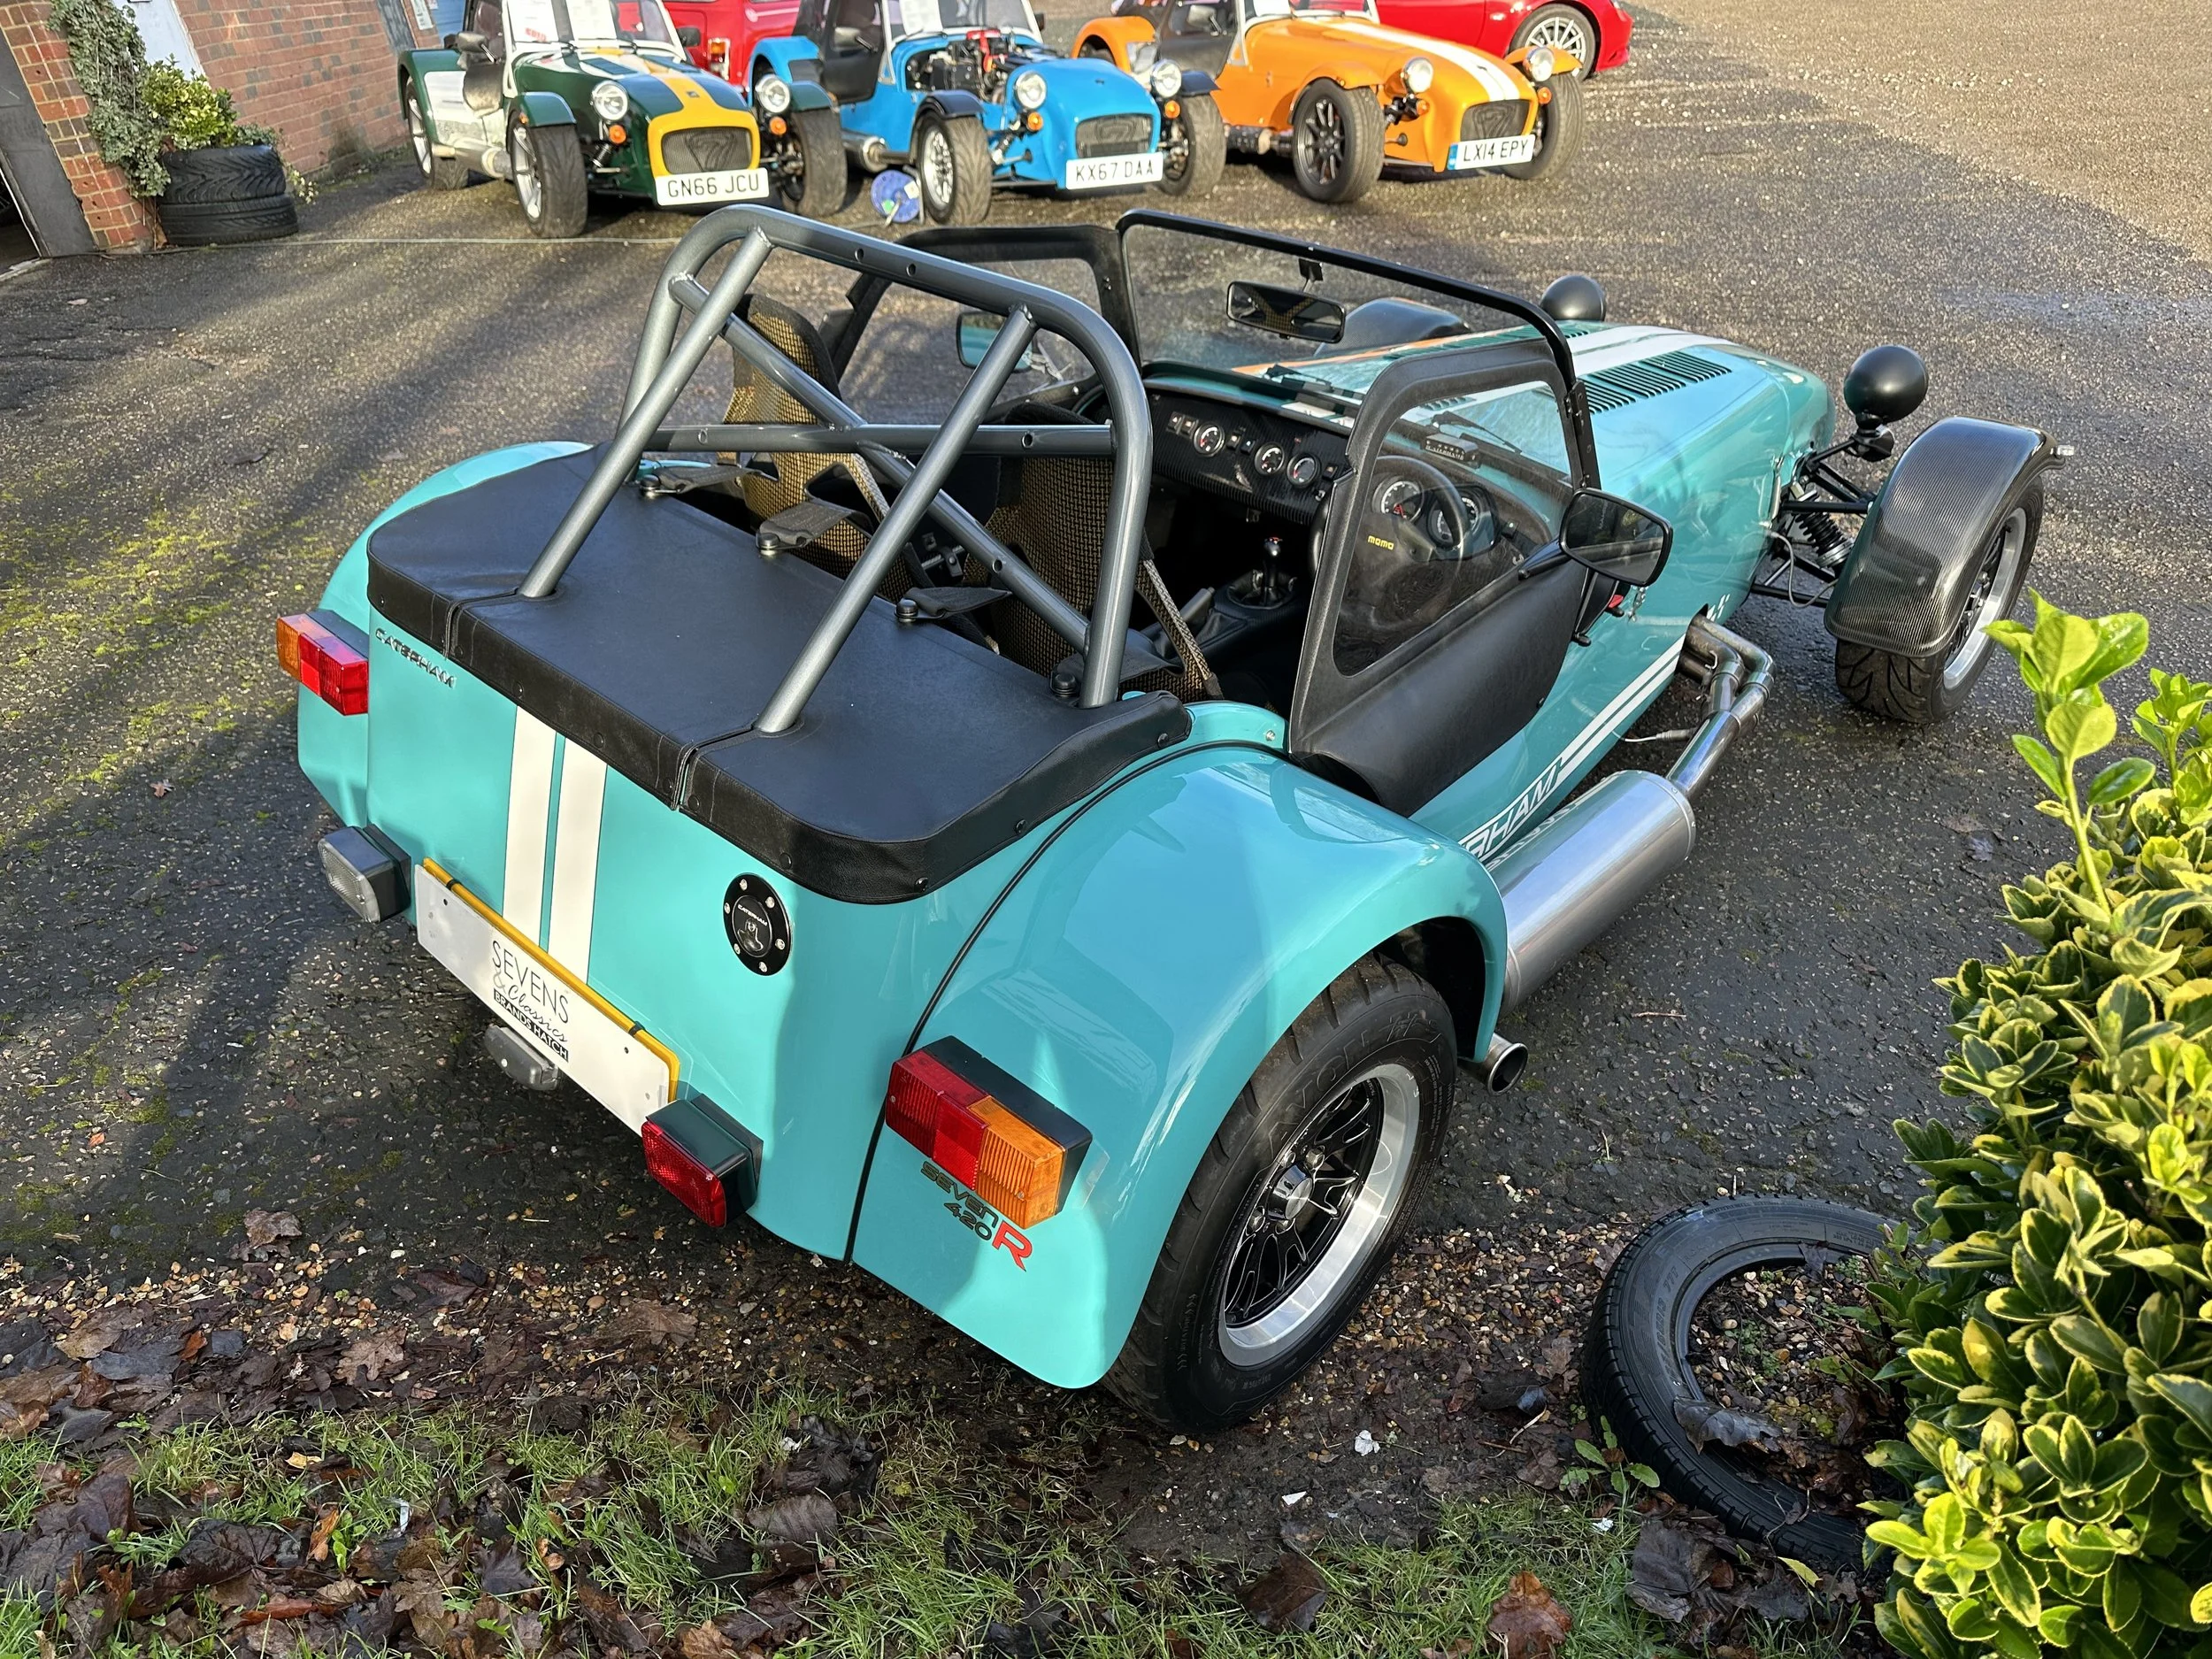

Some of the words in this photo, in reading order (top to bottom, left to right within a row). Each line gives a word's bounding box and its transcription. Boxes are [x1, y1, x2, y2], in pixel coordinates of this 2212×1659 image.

[1076, 162, 1118, 182] KX67
[1124, 159, 1154, 179] DAA
[1463, 142, 1495, 162] LX14
[1500, 139, 1529, 158] EPY
[667, 177, 718, 198] GN66
[725, 173, 759, 194] JCU
[375, 627, 457, 688] CATERHAM
[1462, 763, 1559, 859] RHAM
[492, 940, 569, 1025] SEVENS
[495, 991, 533, 1031] BRANDS
[534, 1025, 567, 1060] HATCH
[508, 984, 568, 1042] Classics
[943, 1202, 993, 1241] 420
